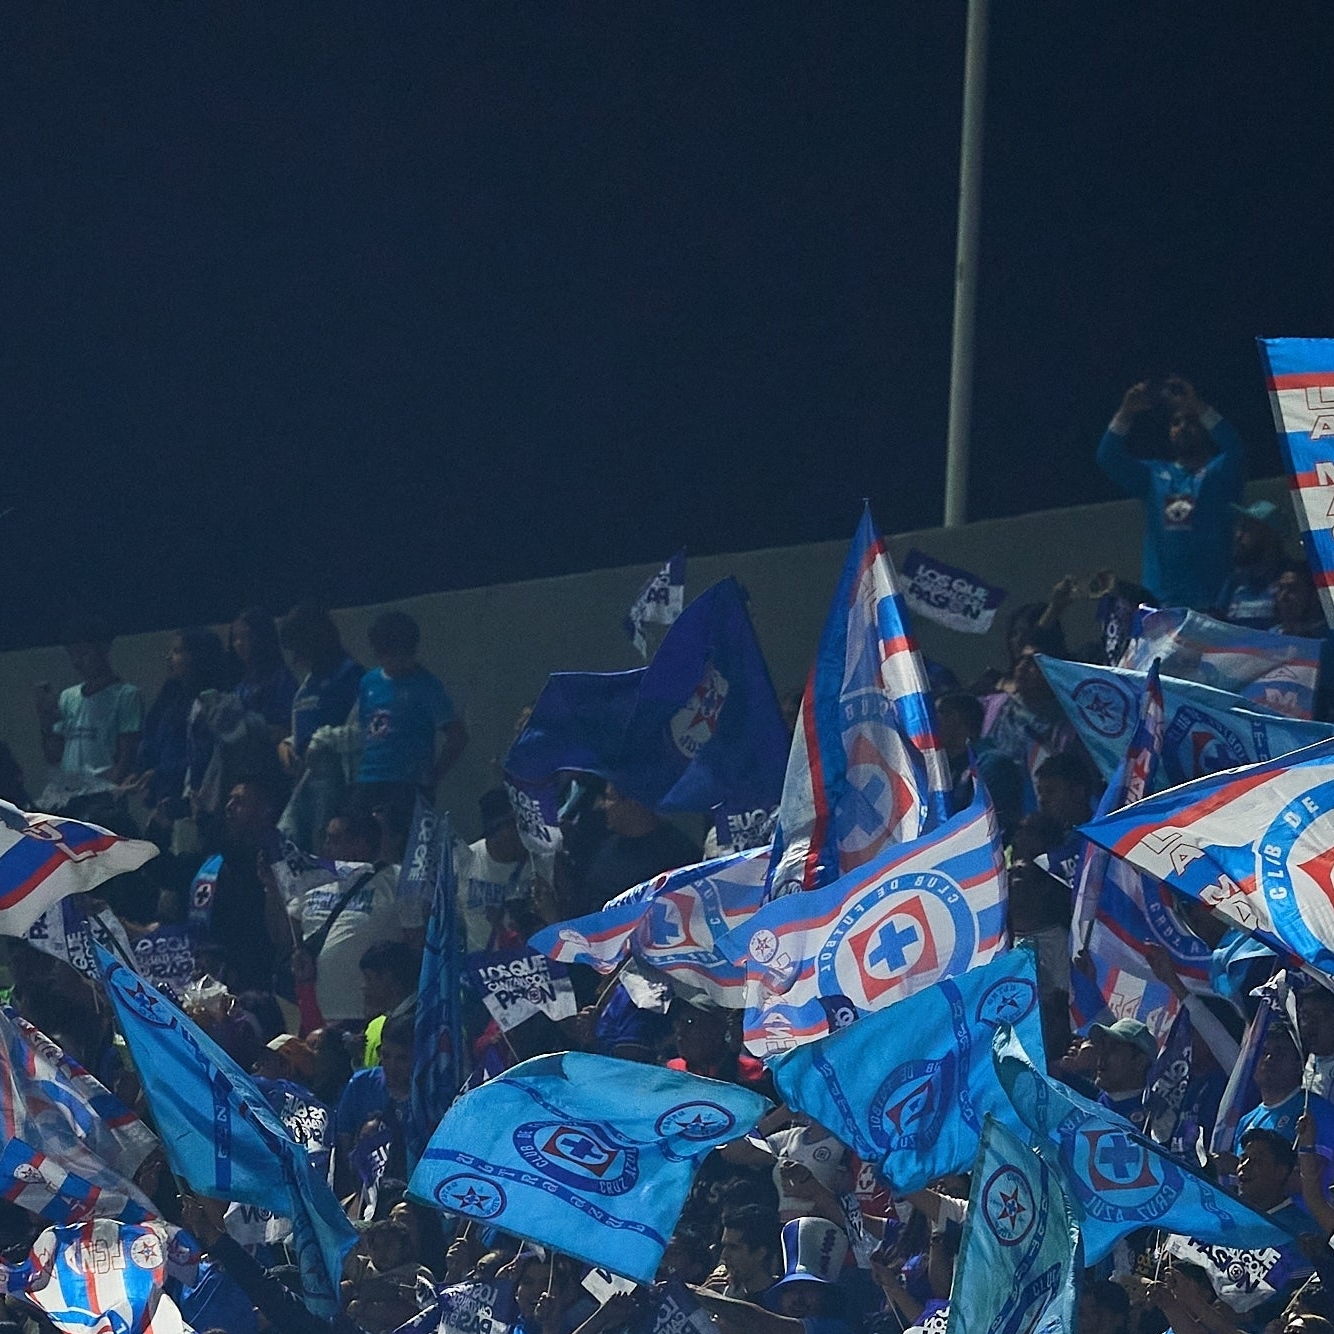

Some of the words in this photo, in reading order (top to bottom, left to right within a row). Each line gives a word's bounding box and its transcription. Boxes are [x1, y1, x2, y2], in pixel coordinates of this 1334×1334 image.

[1285, 796, 1321, 831] DE
[510, 955, 548, 976] QUE
[520, 1143, 549, 1168] CLUB
[599, 1179, 628, 1194] CRUZ
[1255, 1247, 1282, 1271] UE
